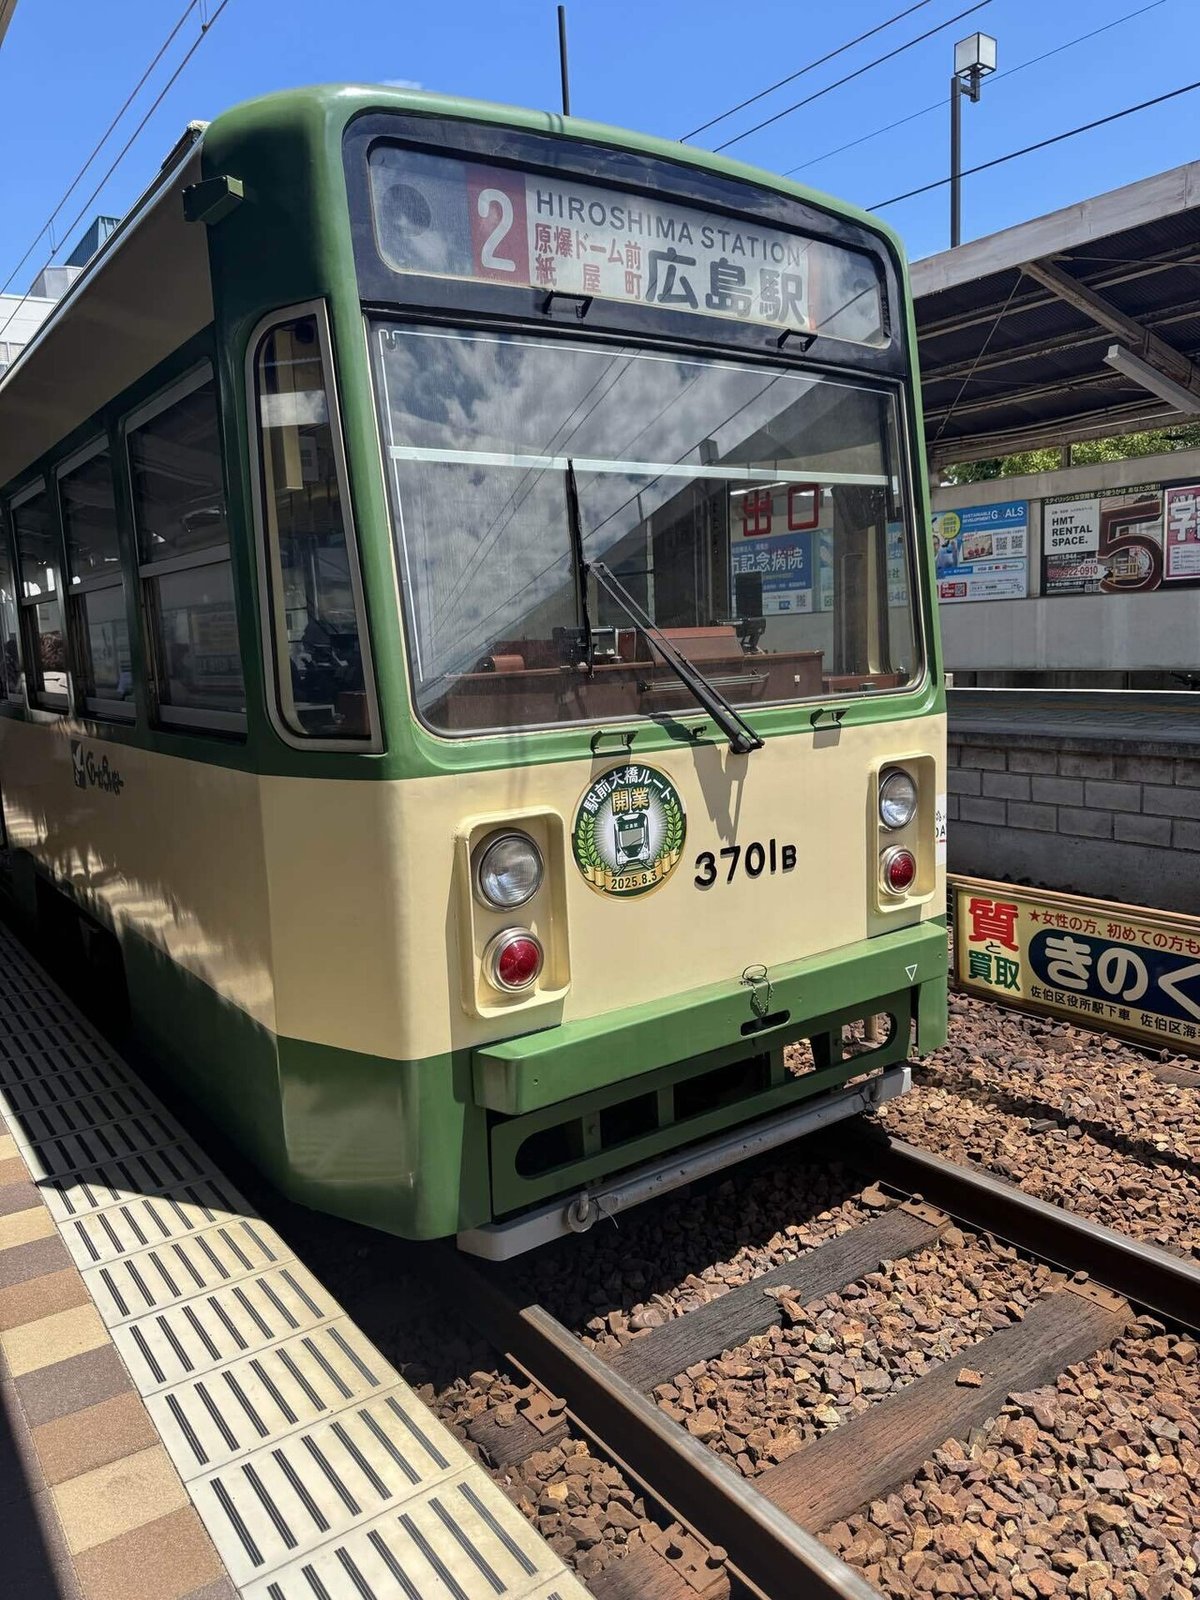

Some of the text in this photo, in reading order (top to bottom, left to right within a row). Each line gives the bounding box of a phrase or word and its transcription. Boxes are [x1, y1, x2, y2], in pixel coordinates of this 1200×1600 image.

[478, 188, 516, 272] 2
[535, 222, 642, 270] 原爆ドーム前
[536, 190, 801, 267] HIROSHIMA STATION
[645, 247, 805, 325] 広島駅
[743, 483, 819, 537] 出口
[1052, 516, 1075, 527] HMT
[1052, 524, 1093, 537] RENTAL
[1170, 494, 1200, 542] 学
[1052, 536, 1089, 547] SPACE.
[583, 766, 671, 814] 駅前大橋ルート
[611, 787, 650, 813] 開業
[611, 871, 658, 890] 2025.8.3
[694, 839, 798, 890] 3701B
[969, 897, 1019, 952] 質
[985, 941, 1001, 955] と
[968, 950, 1021, 992] 買取
[1045, 936, 1200, 1020] きのく
[1031, 985, 1200, 1040] 佐伯区役所駅下車 佐伯区海
